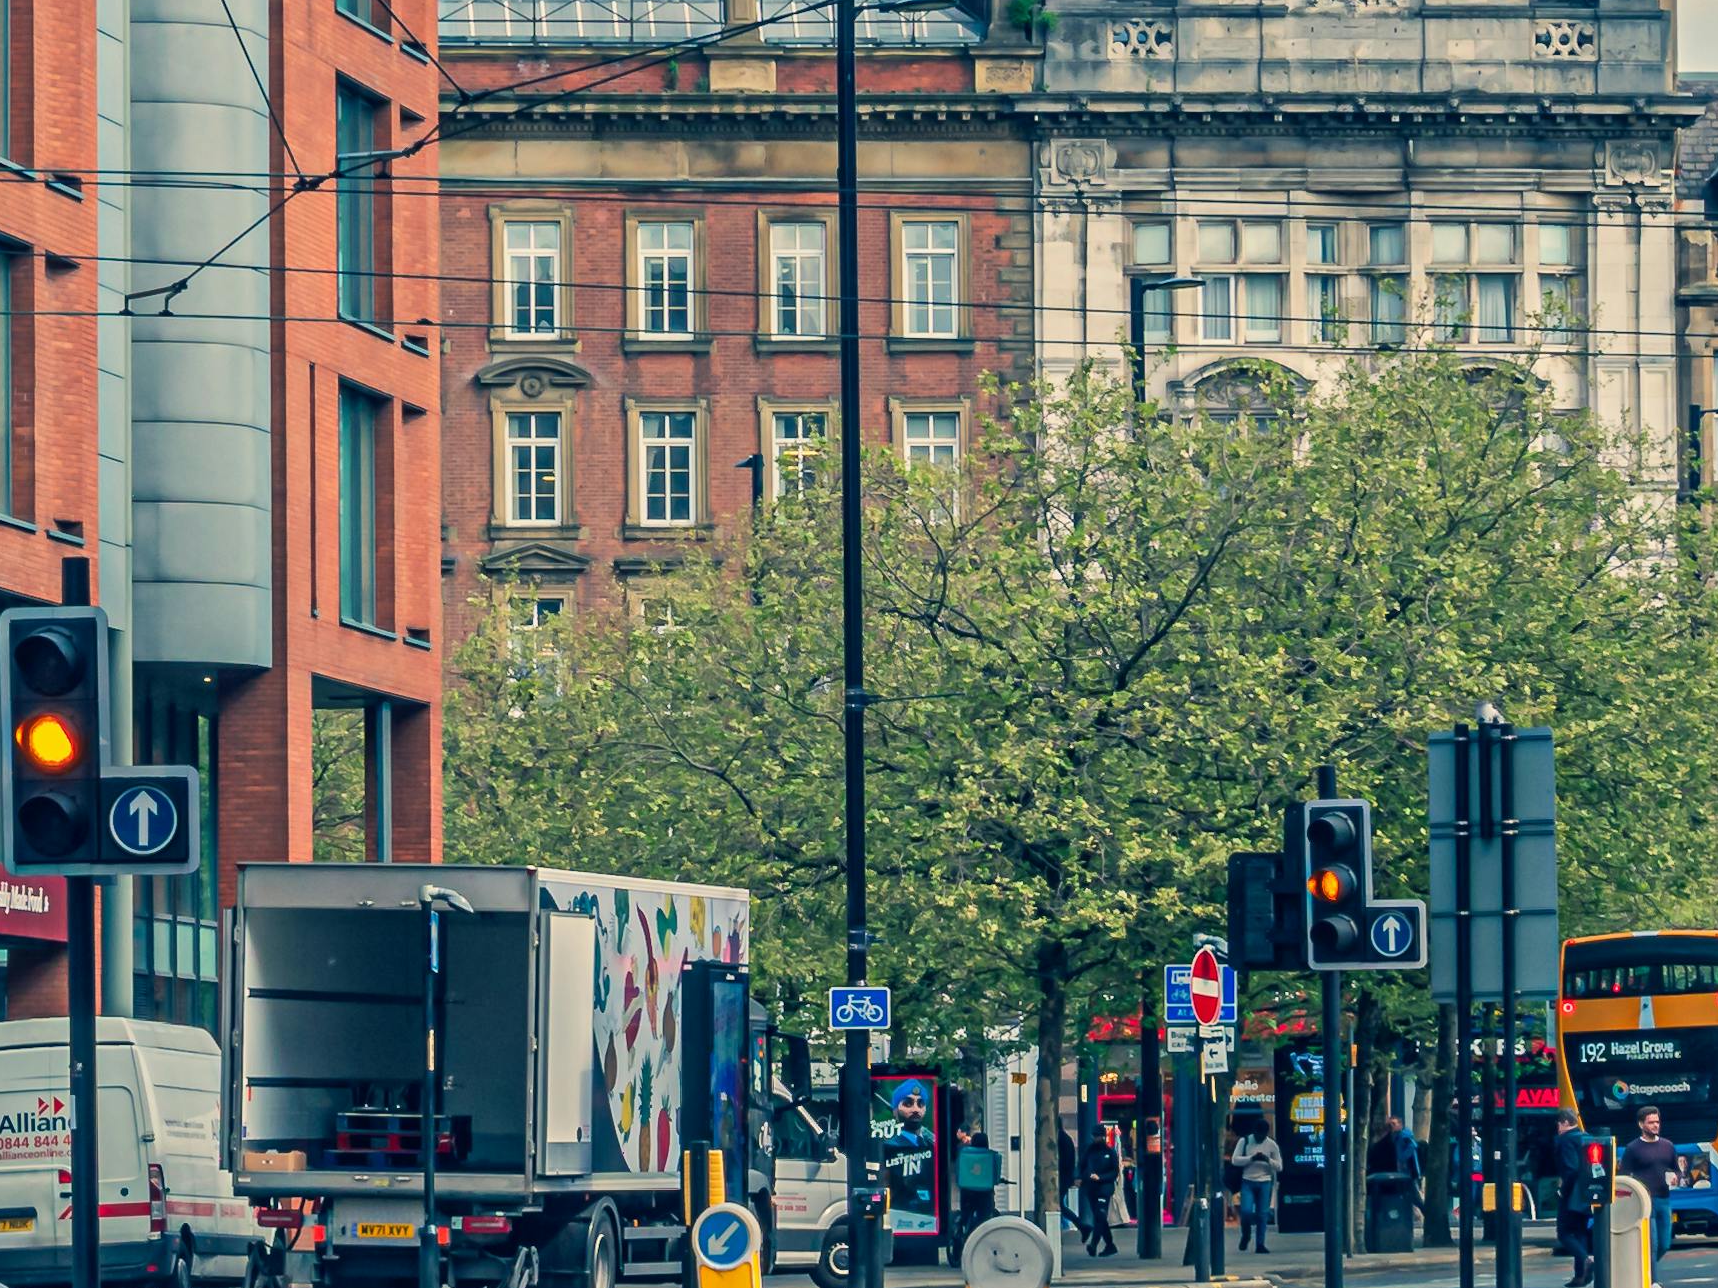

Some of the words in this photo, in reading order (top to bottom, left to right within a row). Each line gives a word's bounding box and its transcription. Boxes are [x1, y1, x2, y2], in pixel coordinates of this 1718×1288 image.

[1580, 1042, 1607, 1063] 192
[1610, 1041, 1640, 1055] Hazel
[1642, 1040, 1675, 1054] Grove
[1629, 1081, 1691, 1096] Stagecoach
[34, 1135, 59, 1148] 844
[885, 1150, 932, 1168] LISTENING
[902, 1160, 922, 1177] IN
